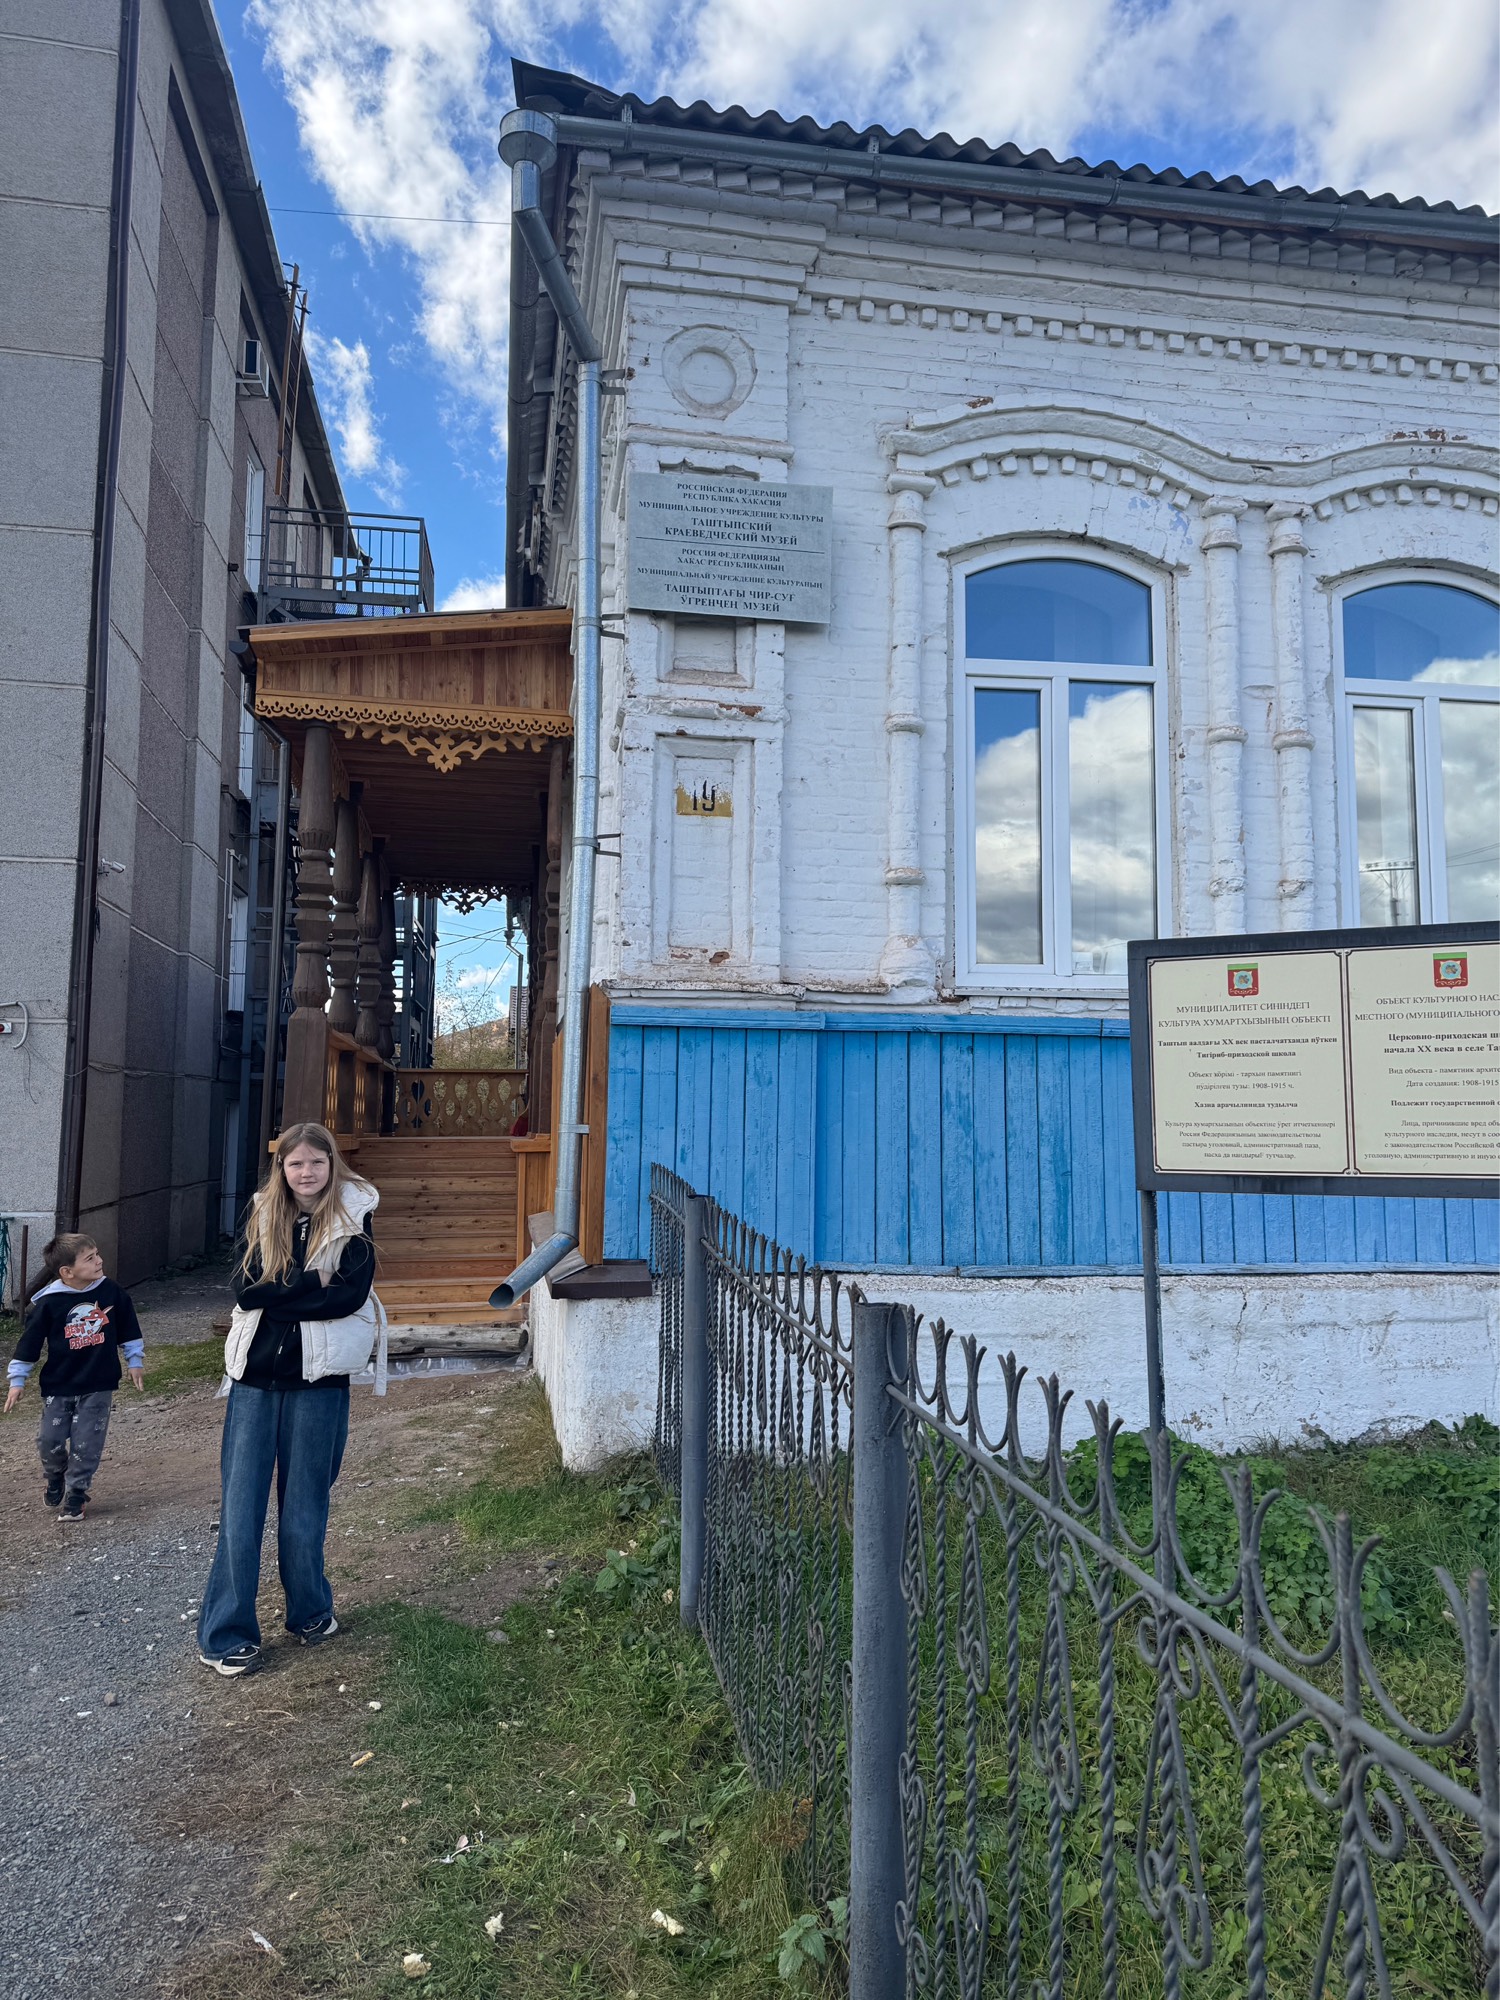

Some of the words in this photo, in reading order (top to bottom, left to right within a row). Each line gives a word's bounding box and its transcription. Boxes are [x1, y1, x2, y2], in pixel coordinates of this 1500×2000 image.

[677, 483, 735, 494] РОССИЙСКАЯ
[737, 488, 787, 498] ФЕДЕРАЦИЯ
[683, 492, 739, 503] РЕСПУБЛИКА
[741, 497, 781, 507] ХАКАСИЯ
[638, 500, 718, 514] МУНИЦИПАЛЬНОЕ
[720, 508, 778, 519] УЧРЕЖДЕНИЕ
[780, 513, 824, 523] КУЛЬТУРЫ
[691, 517, 772, 532] ТАШТЫПСКИЙ
[665, 527, 758, 542] КРАЕВЕДЧЕСКИЙ
[761, 534, 797, 546] МУЗЕЙ
[681, 548, 716, 557] РОССИЯ
[718, 551, 780, 562] ФЕДЕРАЦИЯЗЫ
[677, 557, 706, 566] ХАКАС
[637, 567, 711, 579] МУНИЦИПАЛЬНАЙ
[712, 574, 765, 584] УЧРЕЖДЕНИЕ
[743, 602, 780, 612] МУЗЕЙ
[1376, 997, 1410, 1005] ОБЪЕКТ
[1412, 994, 1478, 1004] КУЛЬТУРНОГО
[1479, 993, 1500, 1002] НАС
[1176, 1003, 1258, 1013] МУНИЦИПАЛИТЕТ
[1355, 1012, 1404, 1021] МЕСТНОГО
[1158, 1019, 1201, 1028] КУЛЬТУРА
[1388, 1032, 1488, 1042] Церковно-приходская
[1487, 1043, 1500, 1051] Та
[1388, 1067, 1403, 1075] Вид
[1406, 1080, 1424, 1088] Дата
[1391, 1099, 1429, 1107] Подлежит
[1430, 1099, 1495, 1107] государственной
[1165, 1120, 1193, 1128] Культура
